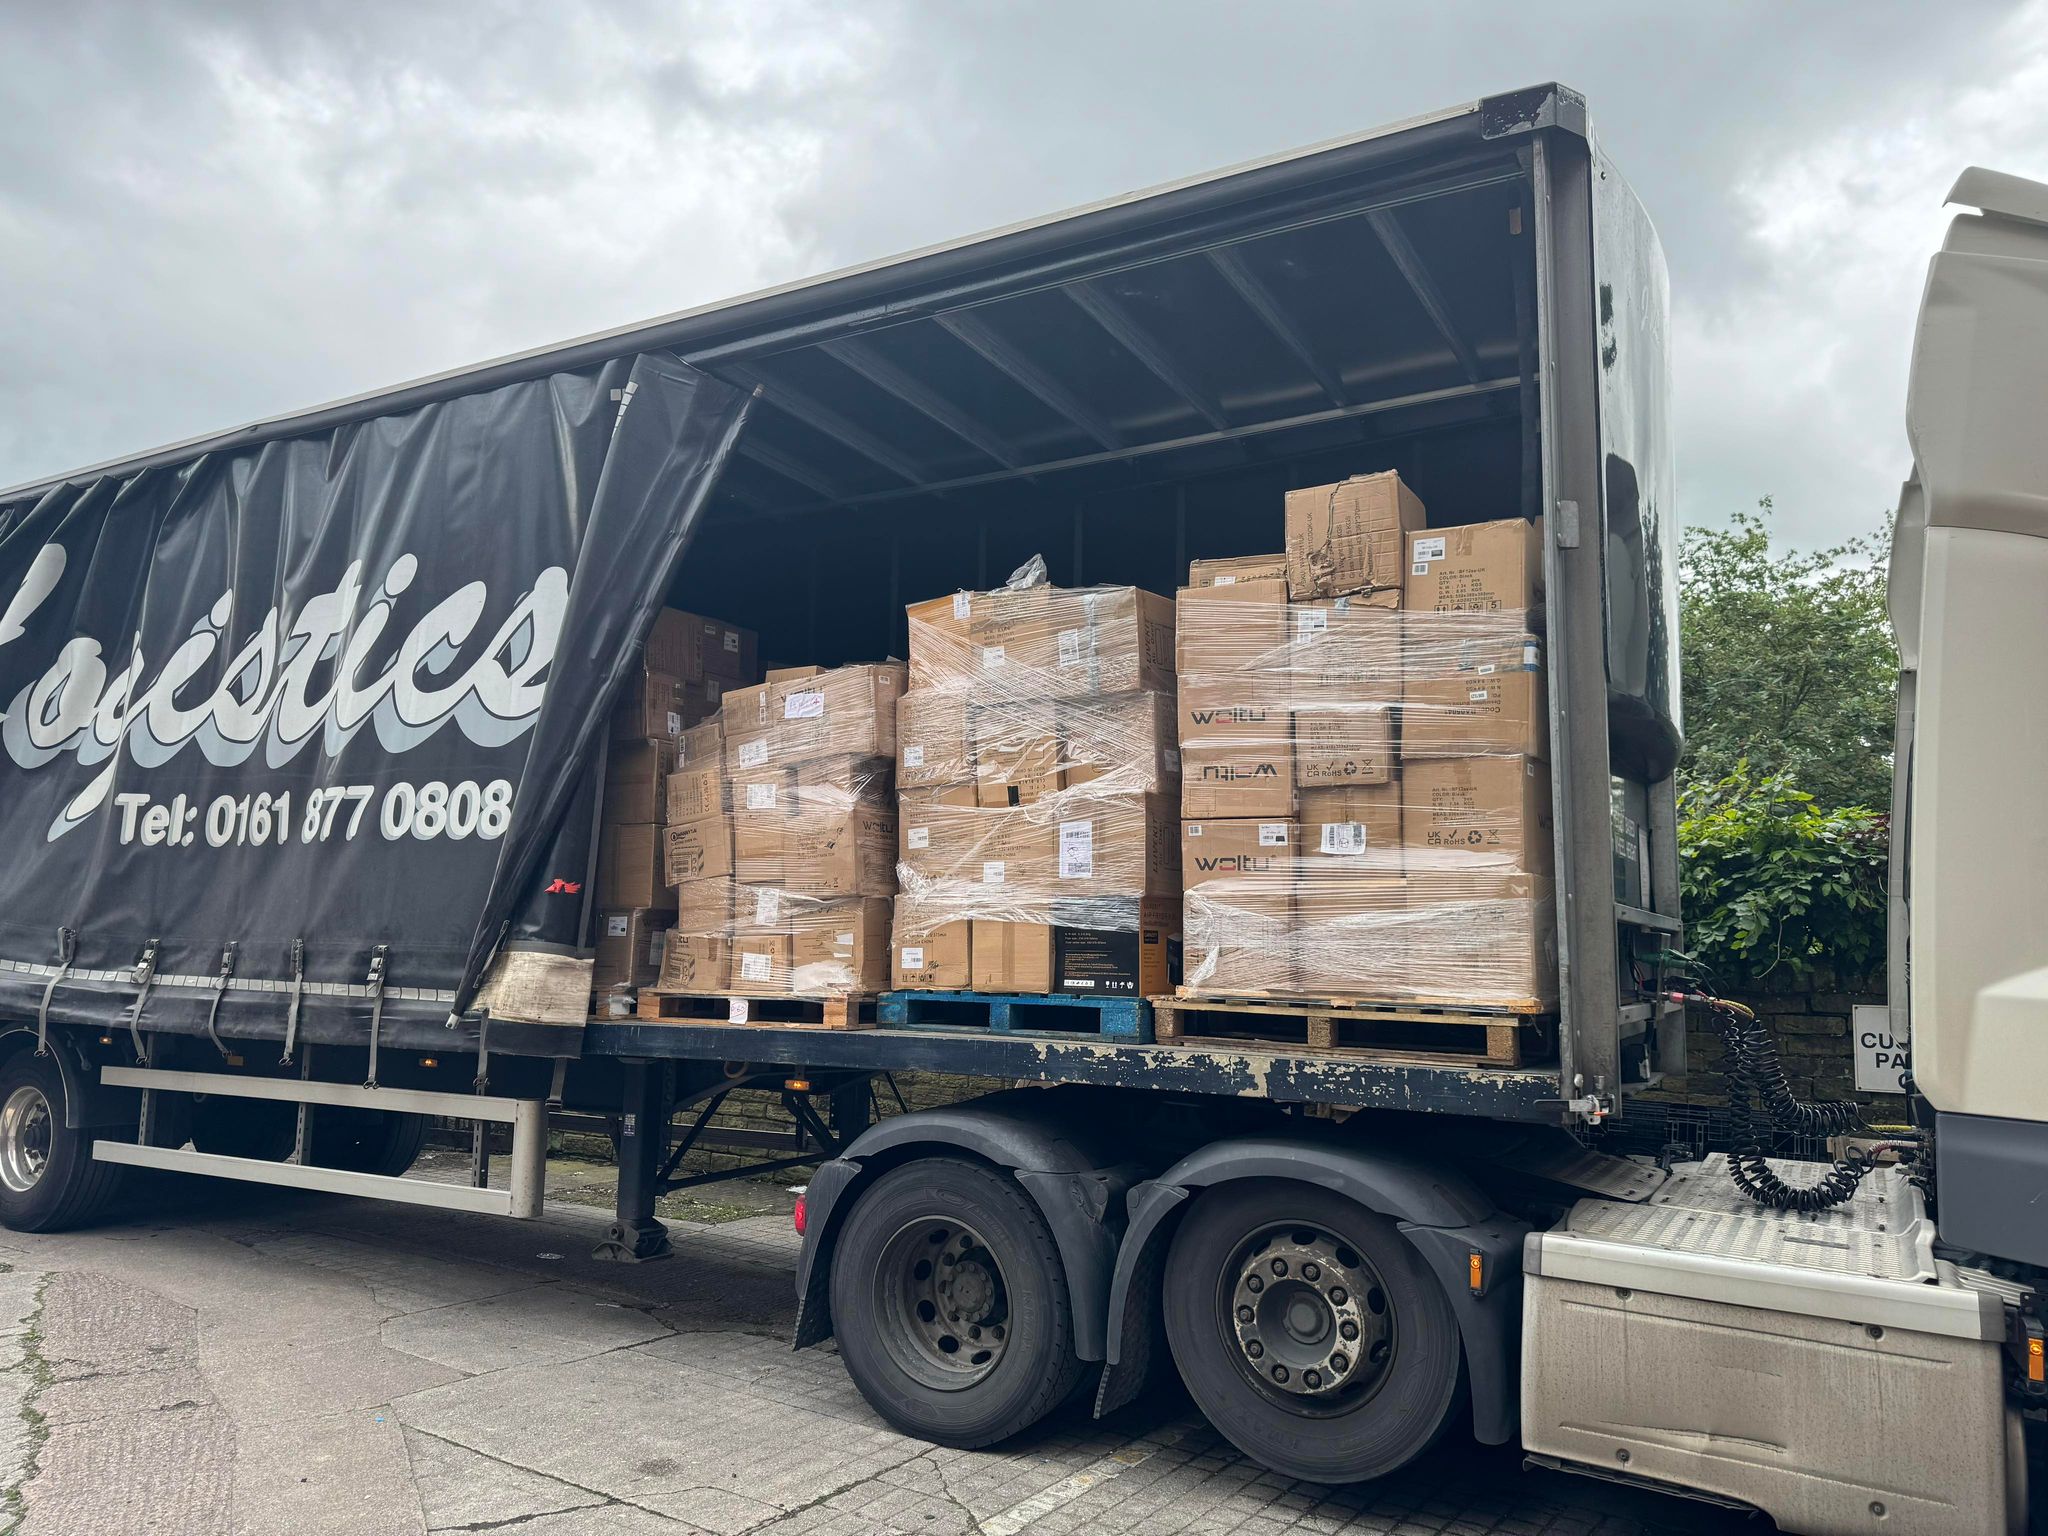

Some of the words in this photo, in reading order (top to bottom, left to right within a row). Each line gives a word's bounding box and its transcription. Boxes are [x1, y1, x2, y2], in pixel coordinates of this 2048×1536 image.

[114, 793, 198, 846] Tel:
[205, 791, 290, 847] 0161
[301, 785, 374, 842] 877
[380, 779, 513, 840] 0808
[1194, 855, 1270, 872] woltu
